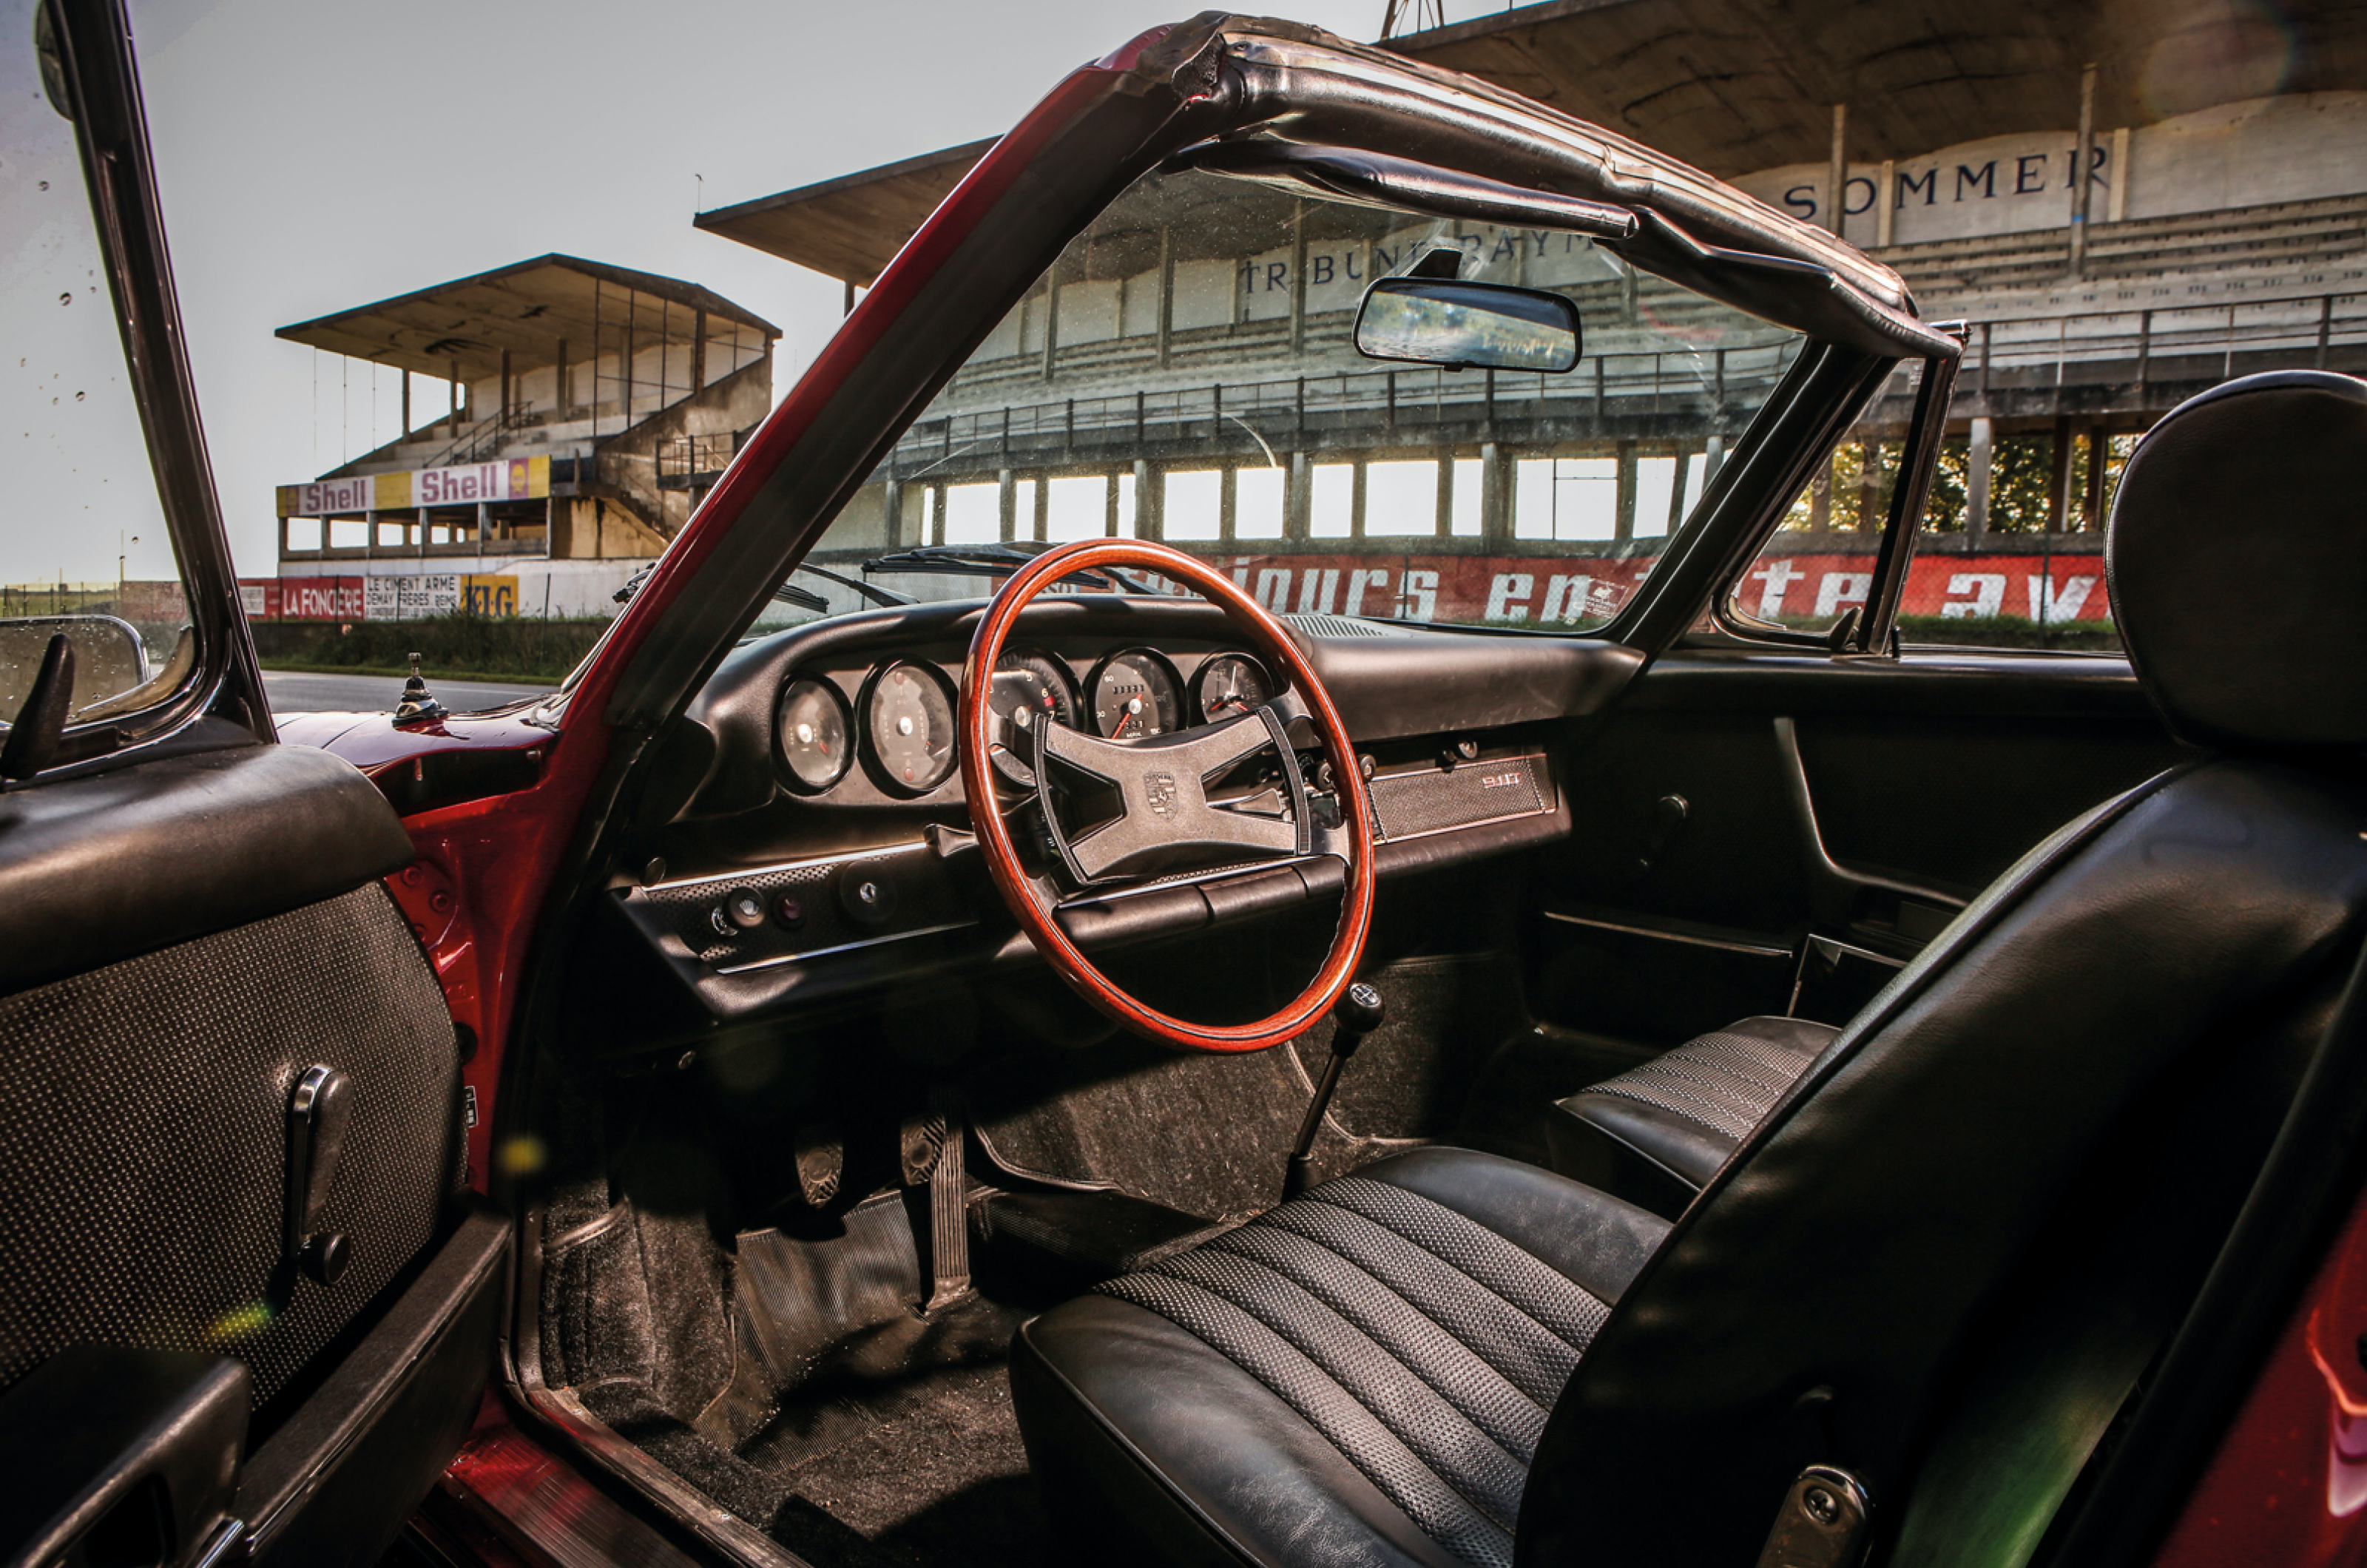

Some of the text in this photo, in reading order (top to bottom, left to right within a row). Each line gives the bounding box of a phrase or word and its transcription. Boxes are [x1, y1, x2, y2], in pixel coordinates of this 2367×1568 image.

[1240, 146, 2110, 294] TRBUN RAYM SOMMER
[306, 479, 366, 511] Shell
[422, 464, 498, 502] Shell
[283, 588, 299, 615] LA
[368, 578, 379, 591] LE
[1483, 572, 1591, 622] en
[1939, 572, 2110, 623] av
